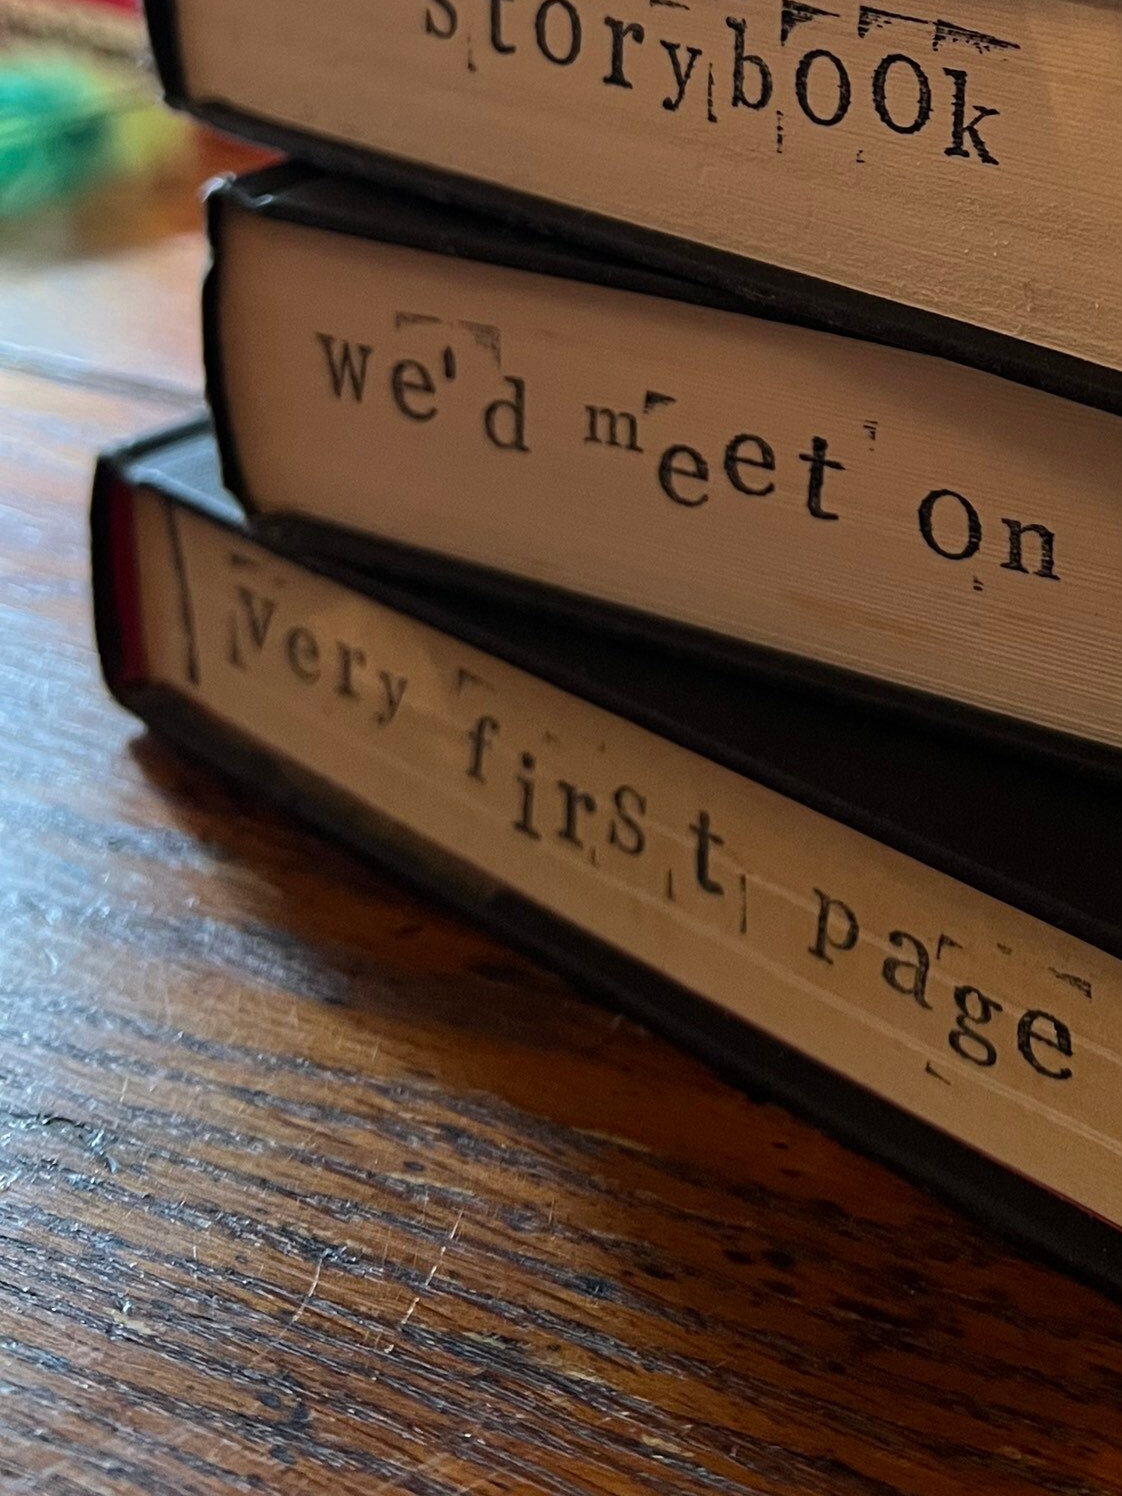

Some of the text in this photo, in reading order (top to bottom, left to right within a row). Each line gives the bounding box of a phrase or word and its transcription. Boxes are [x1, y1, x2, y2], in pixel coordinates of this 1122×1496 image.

[316, 331, 531, 455] we'd
[584, 401, 847, 522] meet
[465, 714, 726, 897] first
[806, 885, 1076, 1082] page
